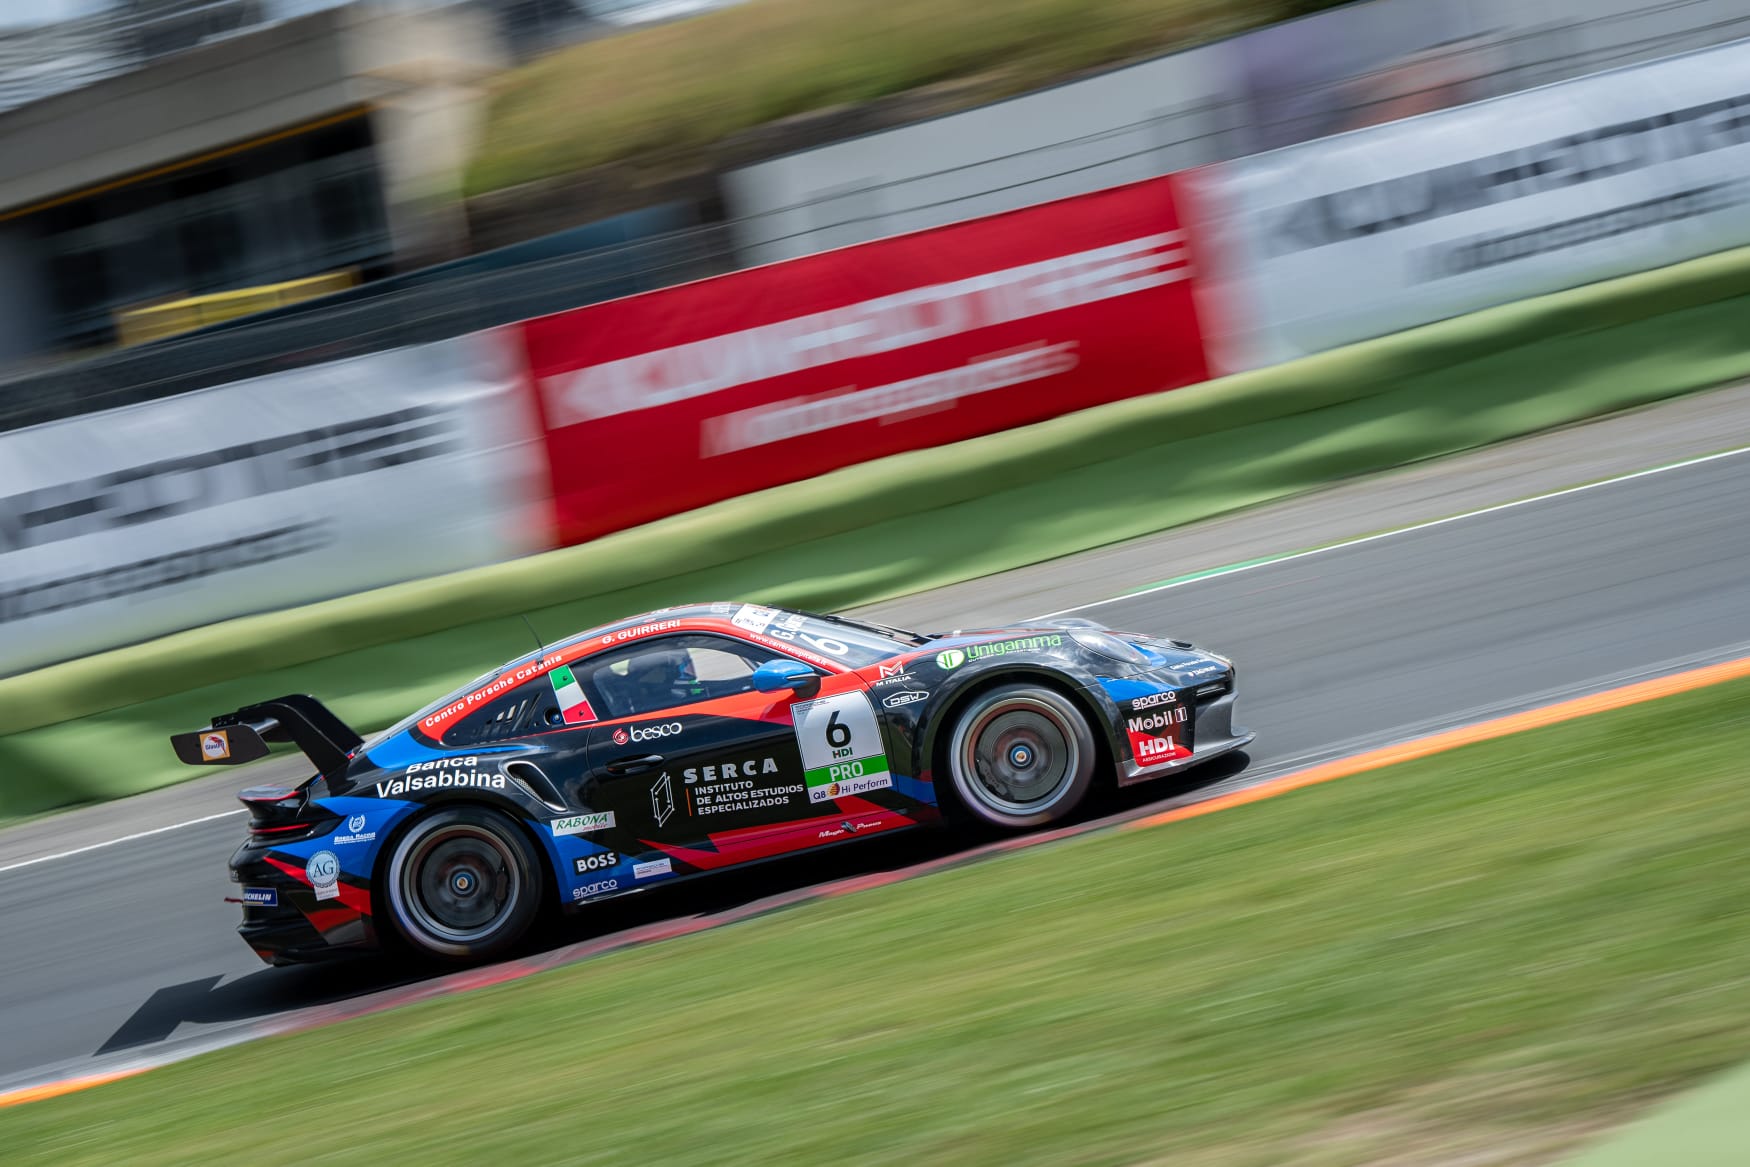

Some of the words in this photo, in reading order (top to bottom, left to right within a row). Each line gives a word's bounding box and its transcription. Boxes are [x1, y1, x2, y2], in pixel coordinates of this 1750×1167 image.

[602, 634, 616, 644] G.
[617, 619, 681, 640] GUIRRERI
[966, 634, 1062, 660] Unigamma
[886, 675, 912, 685] ITALIA
[425, 703, 465, 728] Centro
[466, 676, 514, 705] Porsche
[515, 654, 562, 680] Catania
[890, 694, 920, 706] DSW
[1131, 691, 1177, 711] sparco
[630, 722, 683, 742] besco
[825, 710, 851, 748] 6
[1128, 710, 1173, 733] Mobil
[832, 747, 853, 759] HDI
[1138, 735, 1175, 757] HDI
[406, 756, 478, 774] Banca
[683, 757, 779, 784] SERCA
[829, 761, 864, 782] PRO
[376, 769, 506, 799] Valsabbina
[695, 780, 753, 796] INSTITUTO
[813, 792, 826, 800] Q8
[841, 784, 851, 794] Hi
[853, 778, 888, 792] Perform
[696, 797, 711, 806] DE
[715, 791, 749, 803] ALTOS
[750, 784, 804, 799] ESTUDIOS
[698, 796, 790, 816] ESPECIALIZADOS
[556, 813, 608, 830] RABONA
[313, 860, 334, 878] AG
[576, 852, 617, 873] BOSS
[572, 879, 618, 900] sparco
